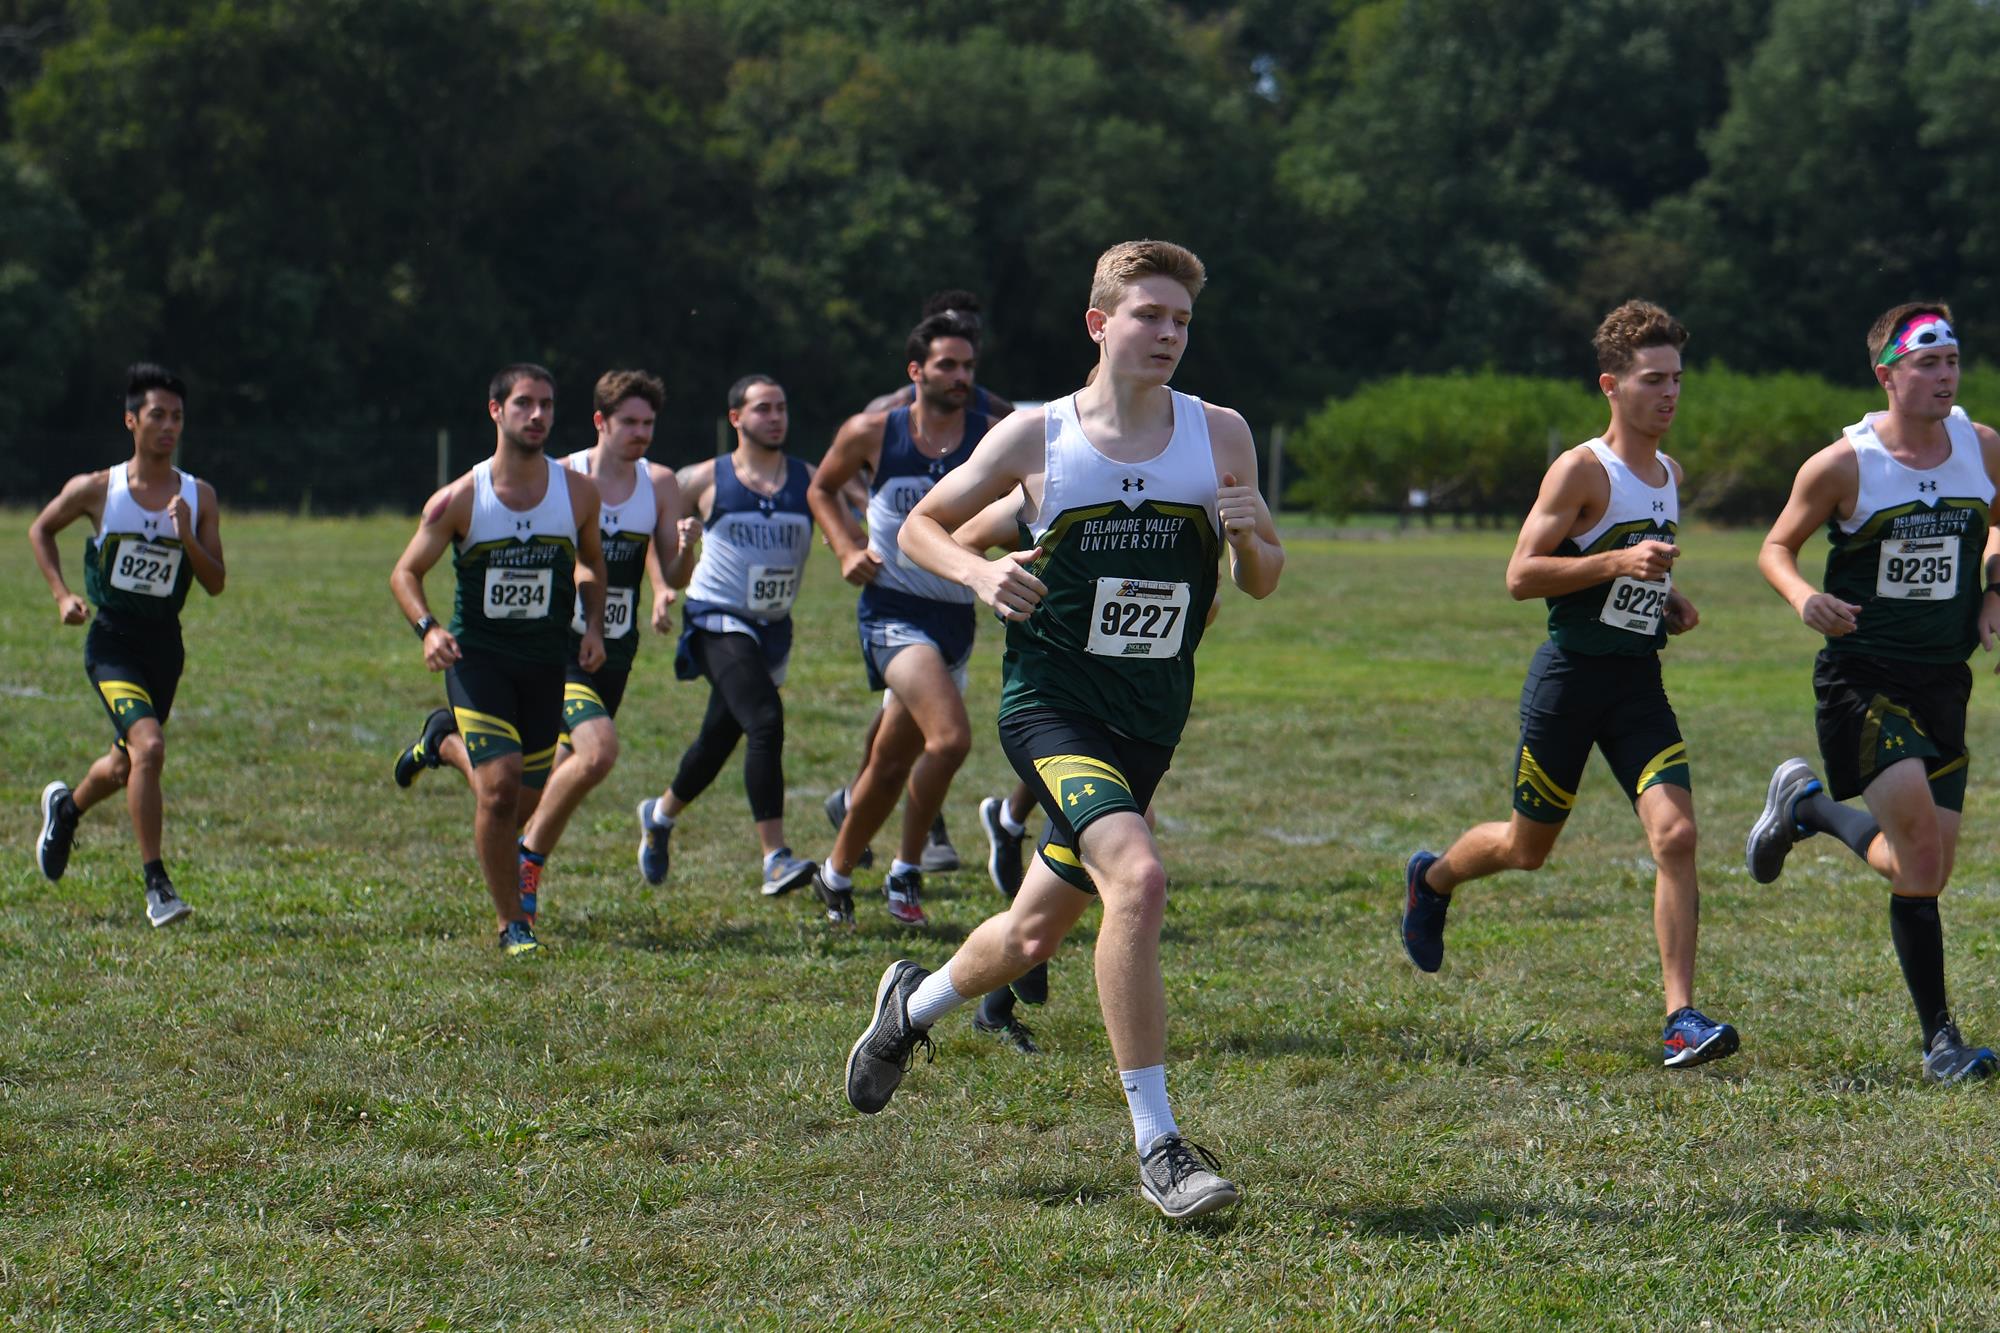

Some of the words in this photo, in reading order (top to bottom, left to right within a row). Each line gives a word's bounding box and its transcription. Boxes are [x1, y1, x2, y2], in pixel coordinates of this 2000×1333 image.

[1084, 518, 1140, 535] DELAWARE
[1145, 518, 1185, 533] VALLEY
[1893, 513, 1937, 528] DELAWARE
[1939, 509, 1971, 522] VALLEY
[1891, 521, 1968, 539] UNIVERSITY
[1080, 533, 1178, 551] UNIVERSITY
[120, 555, 172, 584] 9224
[1887, 556, 1952, 584] 9235
[491, 584, 545, 606] 9234
[1613, 584, 1667, 619] 9225
[1100, 602, 1181, 639] 9227
